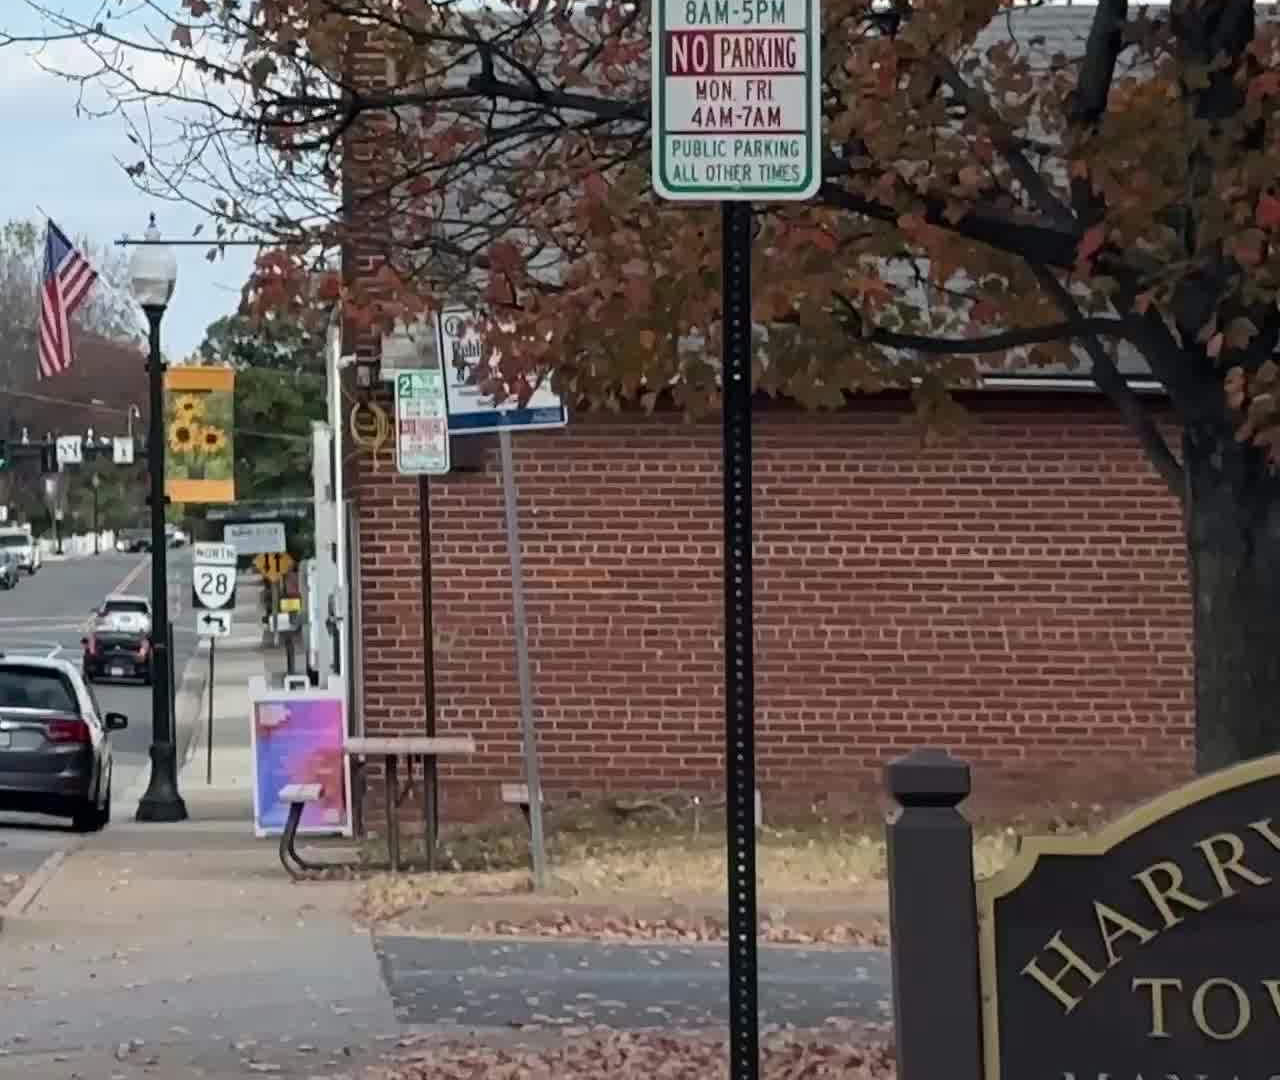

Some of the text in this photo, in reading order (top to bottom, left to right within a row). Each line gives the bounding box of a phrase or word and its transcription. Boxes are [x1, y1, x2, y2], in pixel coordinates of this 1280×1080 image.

[685, 0, 786, 24] 8AM-5PM
[671, 35, 797, 72] NO PARKING
[691, 106, 782, 127] 4AM-7AM
[671, 139, 800, 158] PUBLIC PARKING
[672, 164, 800, 182] ALL OTHER TIMES
[200, 572, 228, 595] 28
[1131, 975, 1280, 1040] TO
